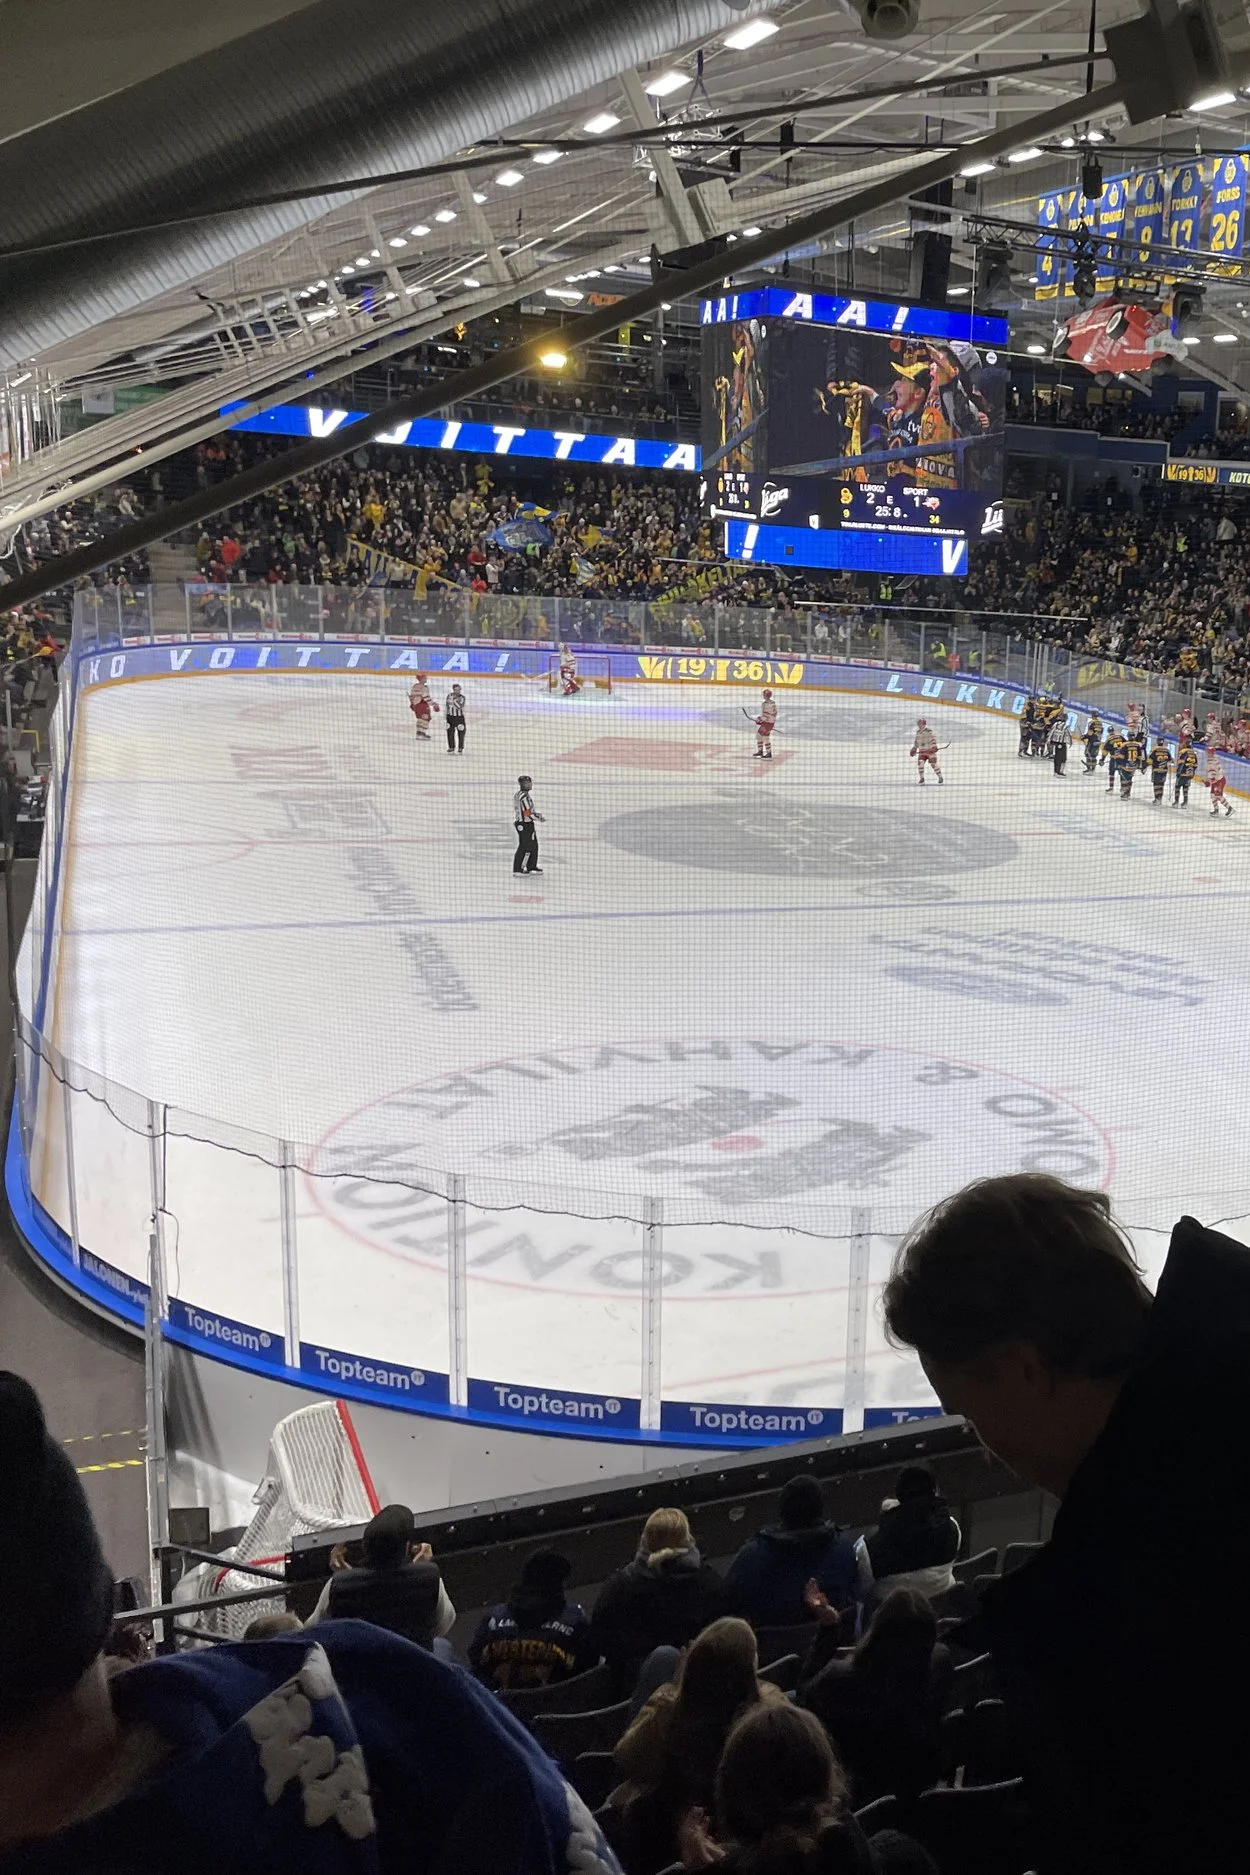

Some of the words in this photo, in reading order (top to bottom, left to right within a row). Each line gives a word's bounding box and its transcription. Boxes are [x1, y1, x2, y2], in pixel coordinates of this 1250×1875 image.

[1211, 210, 1241, 252] 26
[859, 483, 886, 494] LUKKO
[902, 486, 929, 497] SPORT
[866, 493, 875, 504] 2
[886, 495, 894, 505] E
[913, 496, 920, 507] 1
[928, 514, 940, 525] 34
[169, 646, 511, 673] VOITTAA!
[184, 1305, 259, 1352] Topteam
[315, 1349, 411, 1390] Topteam
[493, 1385, 605, 1420] Topteam
[689, 1406, 807, 1433] Topteam
